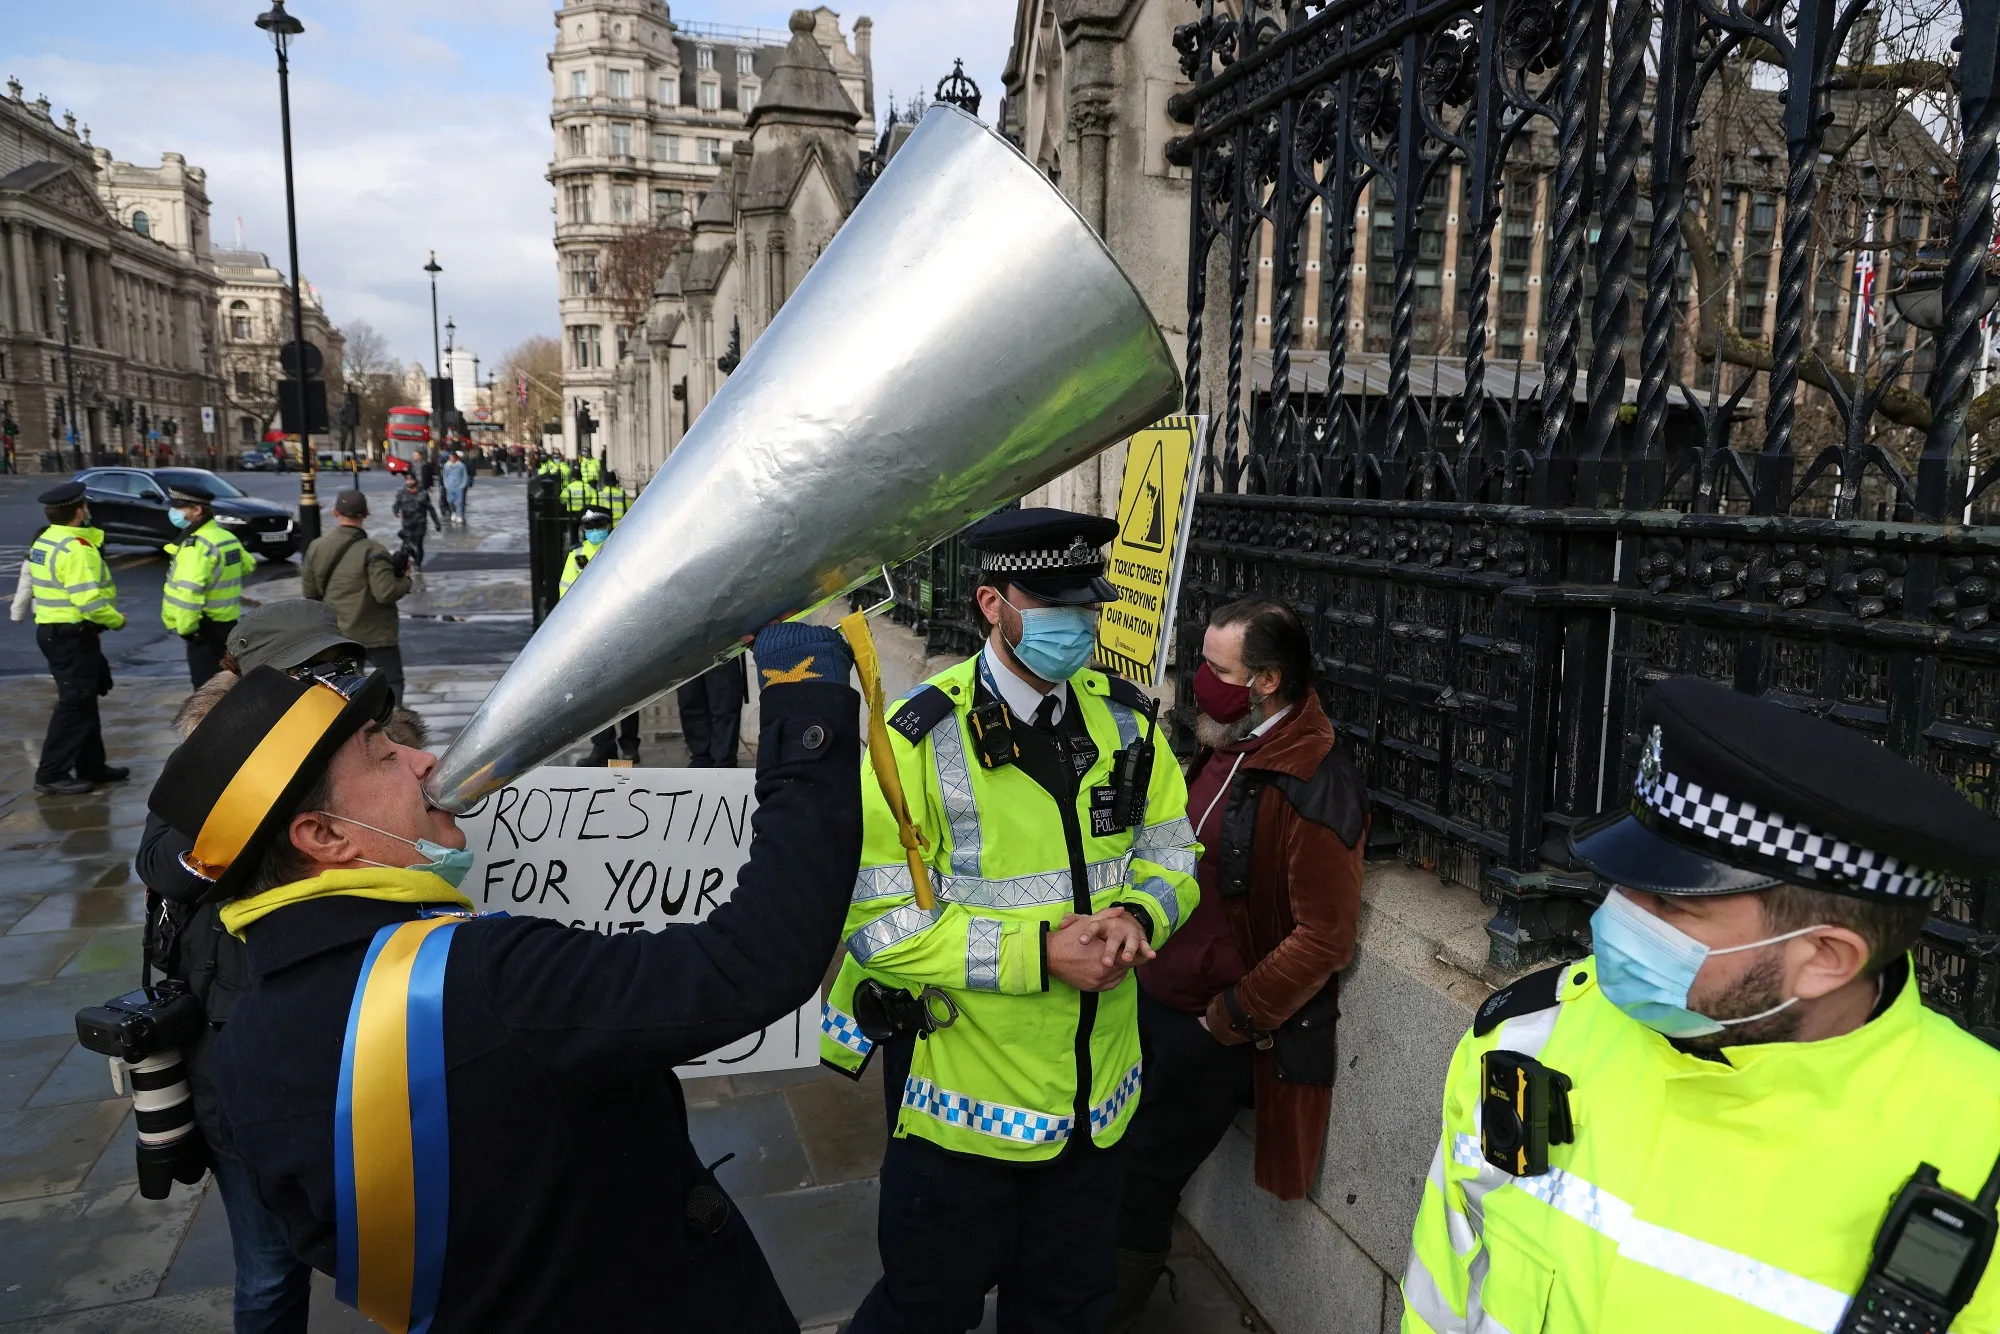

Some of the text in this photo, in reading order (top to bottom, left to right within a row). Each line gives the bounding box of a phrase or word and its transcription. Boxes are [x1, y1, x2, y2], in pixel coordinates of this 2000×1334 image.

[1114, 558, 1163, 586] TOXIC TORIES
[1106, 607, 1154, 638] OUR NATION
[895, 716, 920, 735] 4205
[906, 711, 920, 724] EA
[454, 786, 754, 852] ROTESTIN
[483, 858, 725, 916] FOR YOUR
